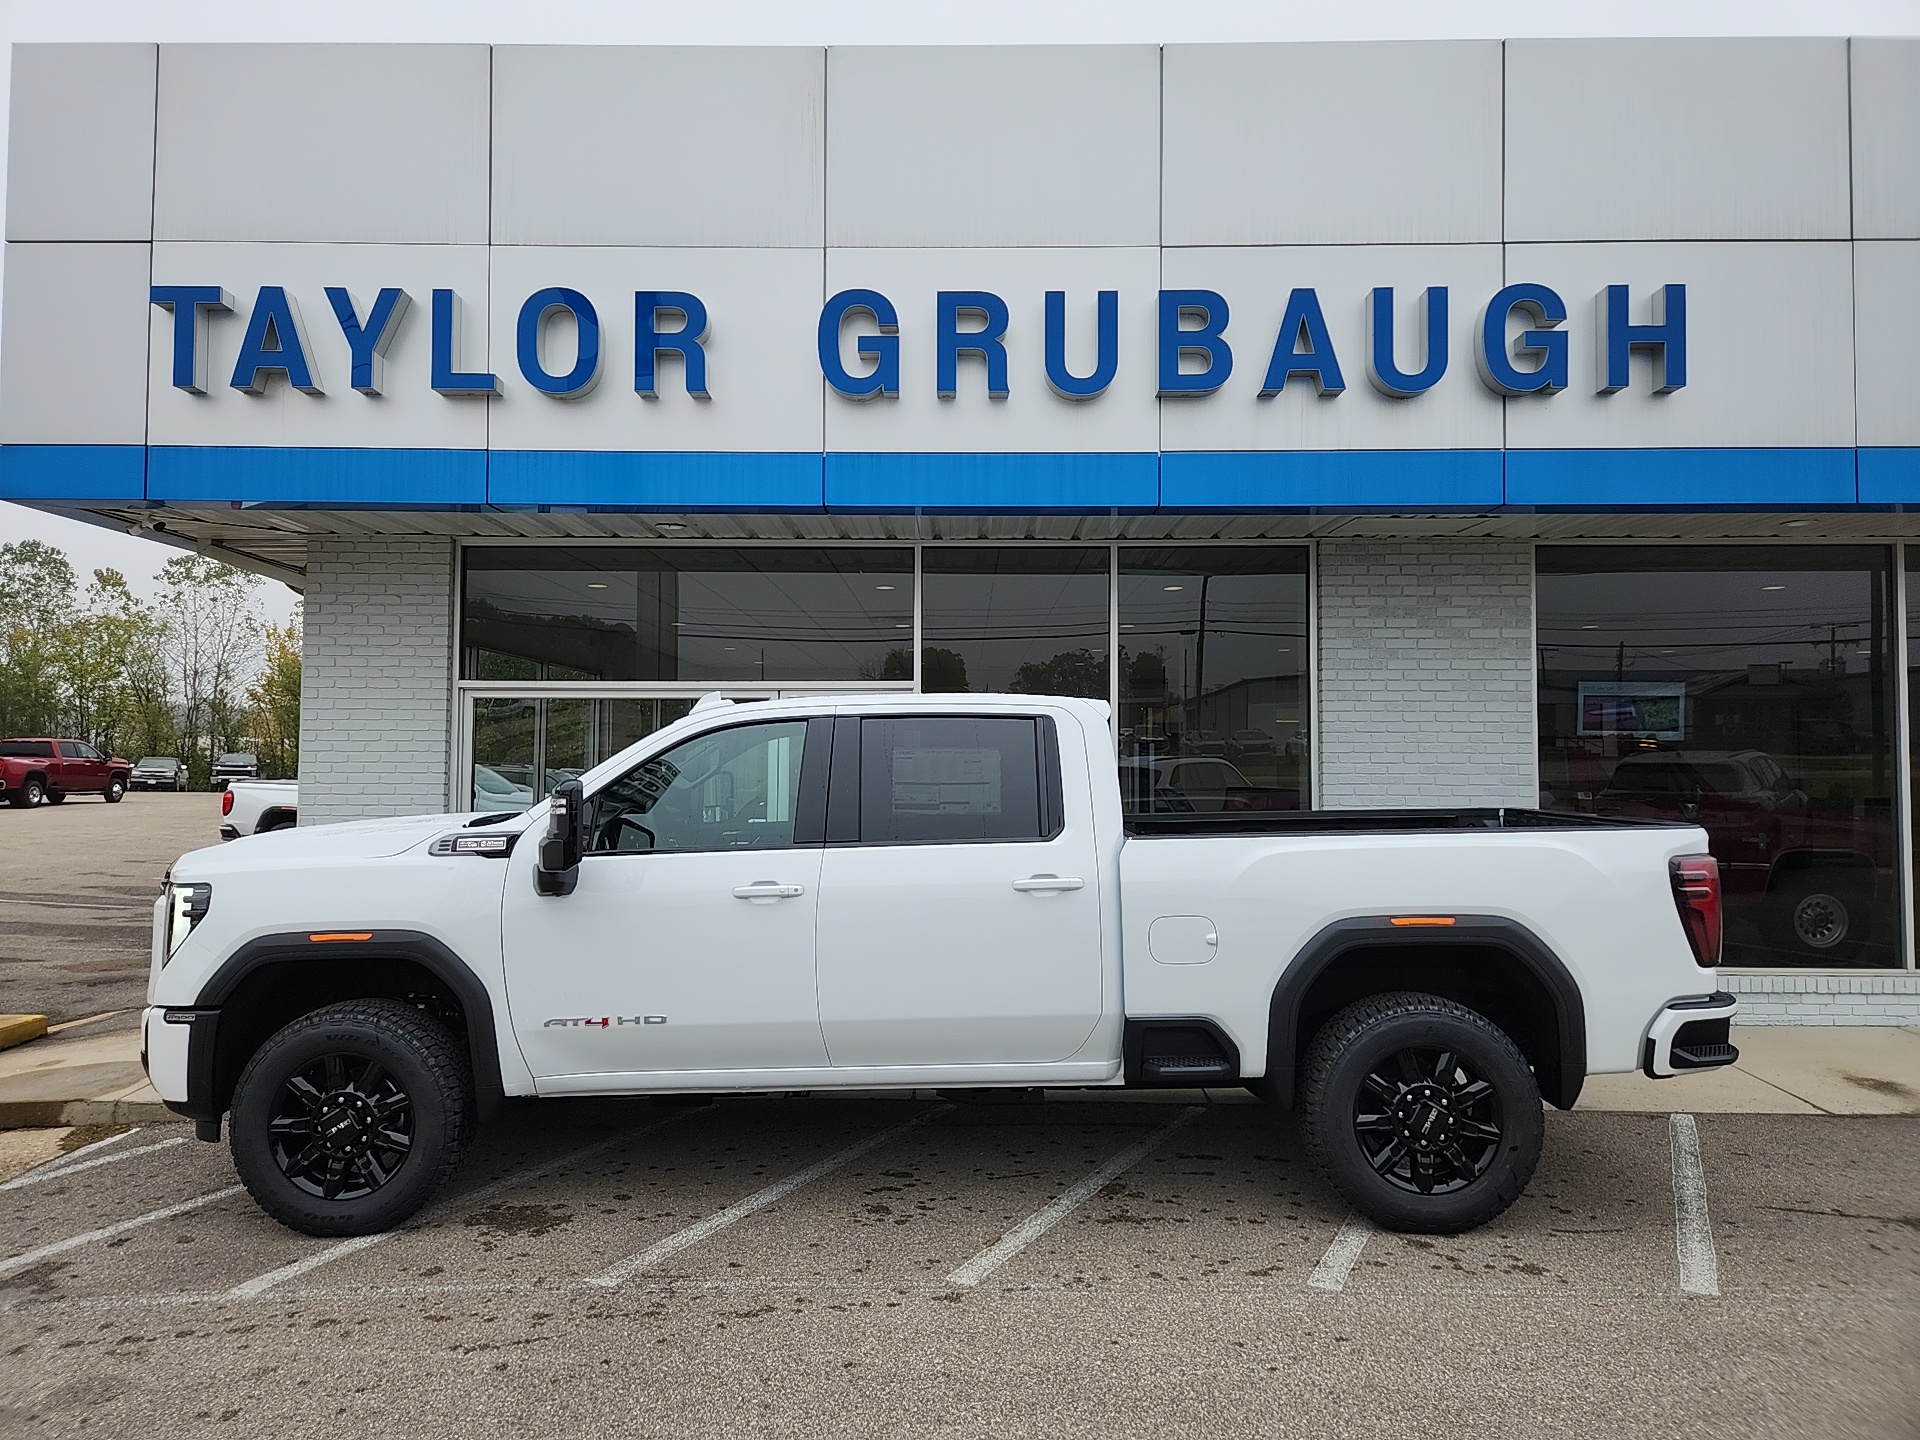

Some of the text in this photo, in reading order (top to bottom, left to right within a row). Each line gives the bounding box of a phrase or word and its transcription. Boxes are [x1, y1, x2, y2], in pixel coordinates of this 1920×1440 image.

[150, 282, 1687, 400] TAYLOR GRUBAUGH
[543, 1014, 668, 1029] AT4 HD
